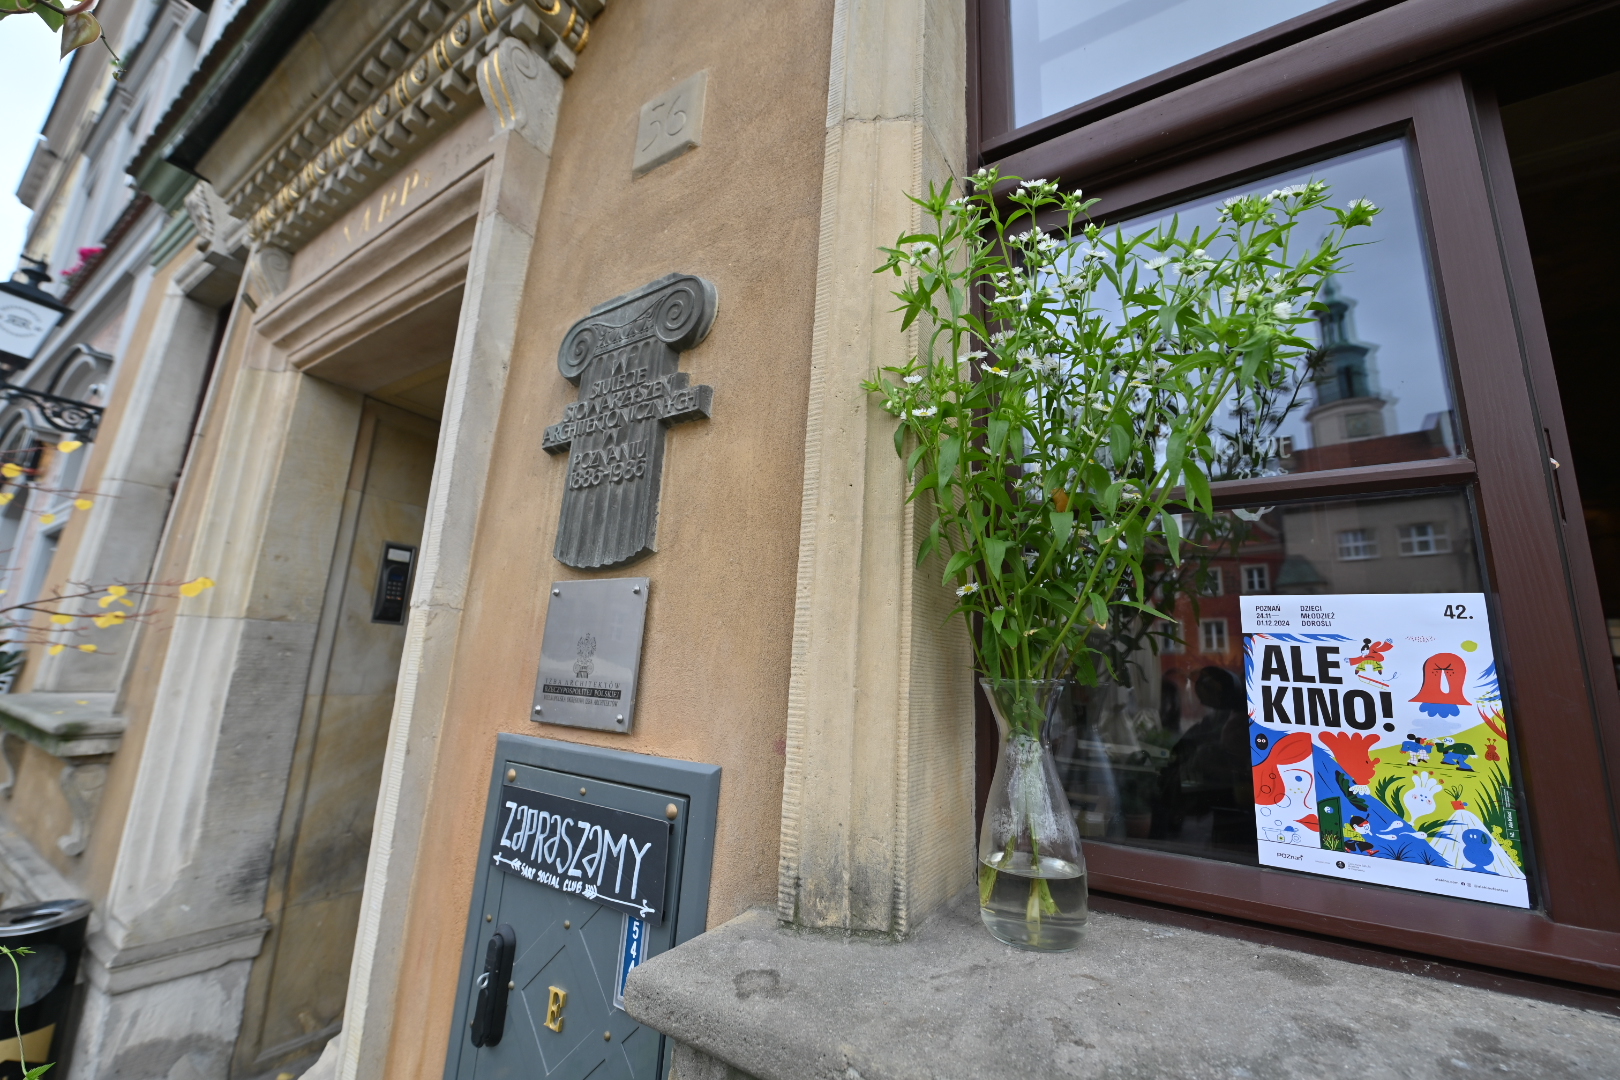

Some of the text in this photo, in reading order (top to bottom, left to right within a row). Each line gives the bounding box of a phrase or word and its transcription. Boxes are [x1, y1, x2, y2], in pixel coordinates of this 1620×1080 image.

[589, 367, 648, 400] STULECIE
[574, 439, 648, 469] POZNANIU
[1255, 603, 1281, 612] POZNAŃ
[1443, 604, 1474, 620] 42.
[1256, 619, 1290, 627] 01.12.2024
[1301, 618, 1332, 627] DOROŚLI
[1261, 644, 1343, 685] ALE
[593, 690, 620, 699] POLSKIEJ
[1261, 685, 1395, 732] KINO!
[537, 870, 560, 889] SOCIAL
[562, 878, 583, 894] CLUB
[544, 985, 567, 1033] E
